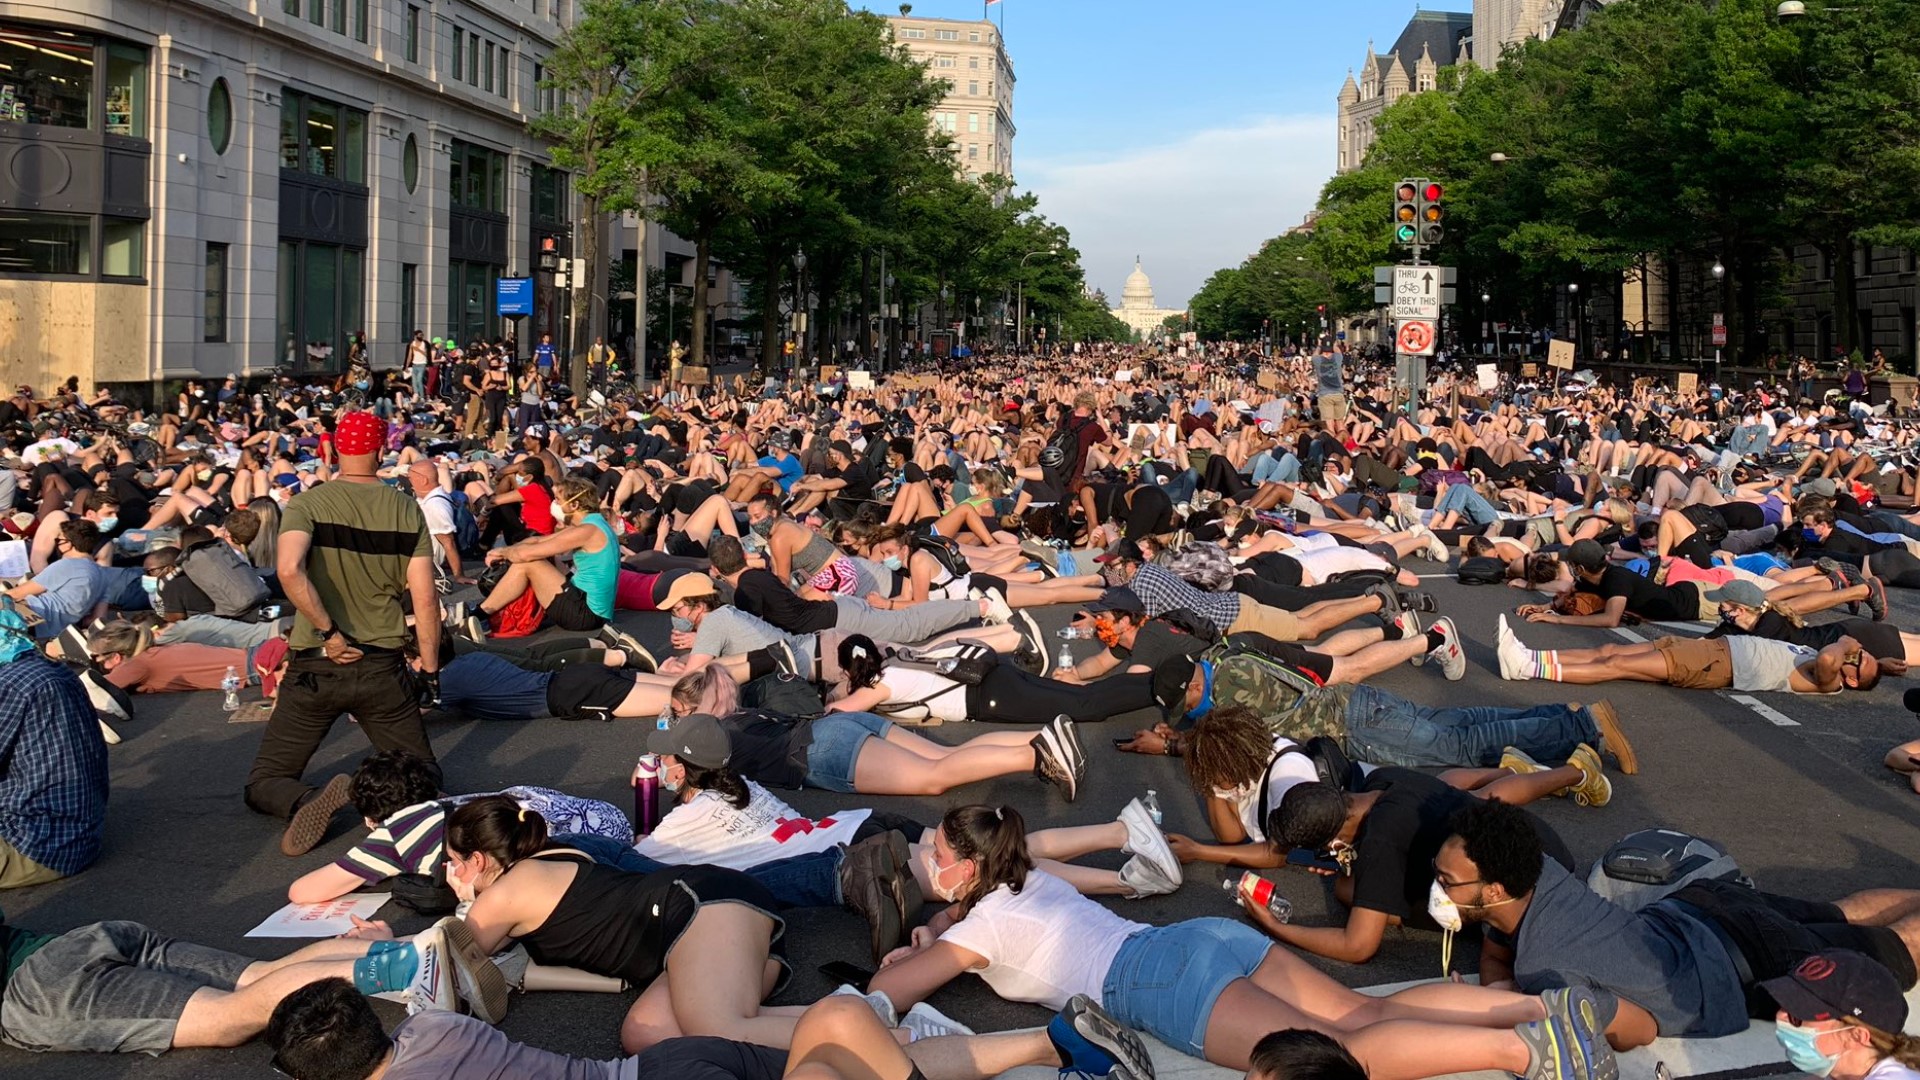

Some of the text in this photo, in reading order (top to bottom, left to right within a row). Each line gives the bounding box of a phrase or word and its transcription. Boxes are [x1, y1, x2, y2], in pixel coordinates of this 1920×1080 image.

[1398, 269, 1418, 279] THRU
[1396, 296, 1436, 306] OBEY THIS
[1396, 306, 1423, 315] SIGNAL
[726, 815, 746, 835] NOT
